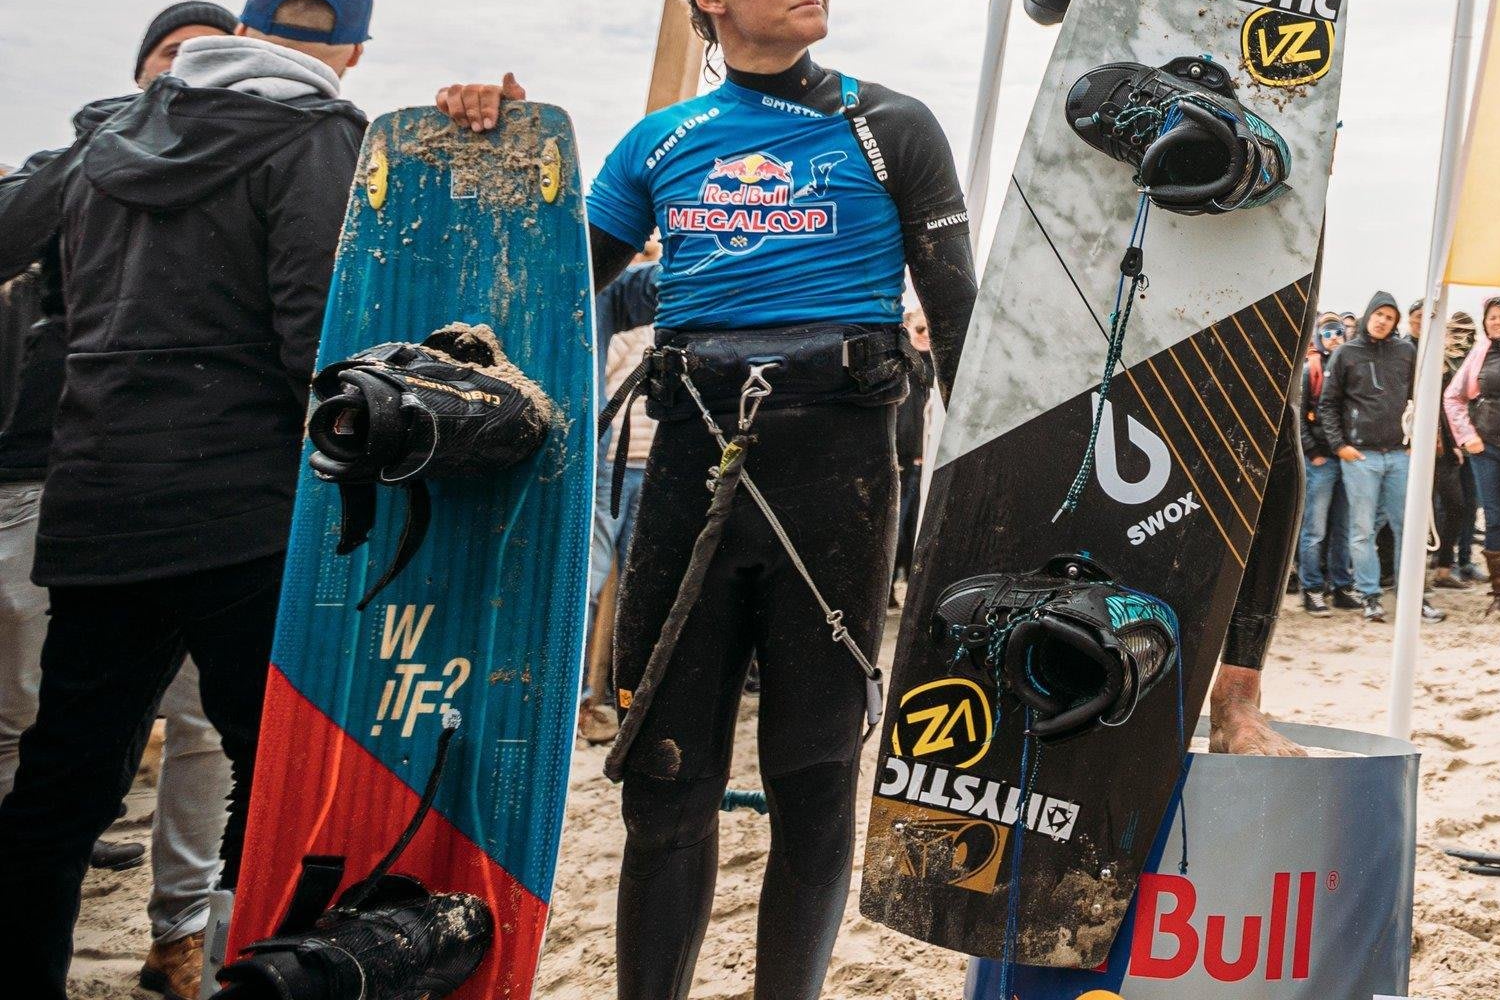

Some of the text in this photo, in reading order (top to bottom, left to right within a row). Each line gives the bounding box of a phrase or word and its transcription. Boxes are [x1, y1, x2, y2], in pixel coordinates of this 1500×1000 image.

[646, 107, 720, 170] SAMSUNG
[773, 100, 824, 118] MYSTIC
[853, 116, 888, 181] AMSUNG
[668, 208, 828, 233] MEGALOOP
[703, 184, 788, 206] Red Bull
[1126, 491, 1201, 547] SWOX
[878, 757, 1043, 831] MYSTIC
[1128, 871, 1317, 982] Bull
